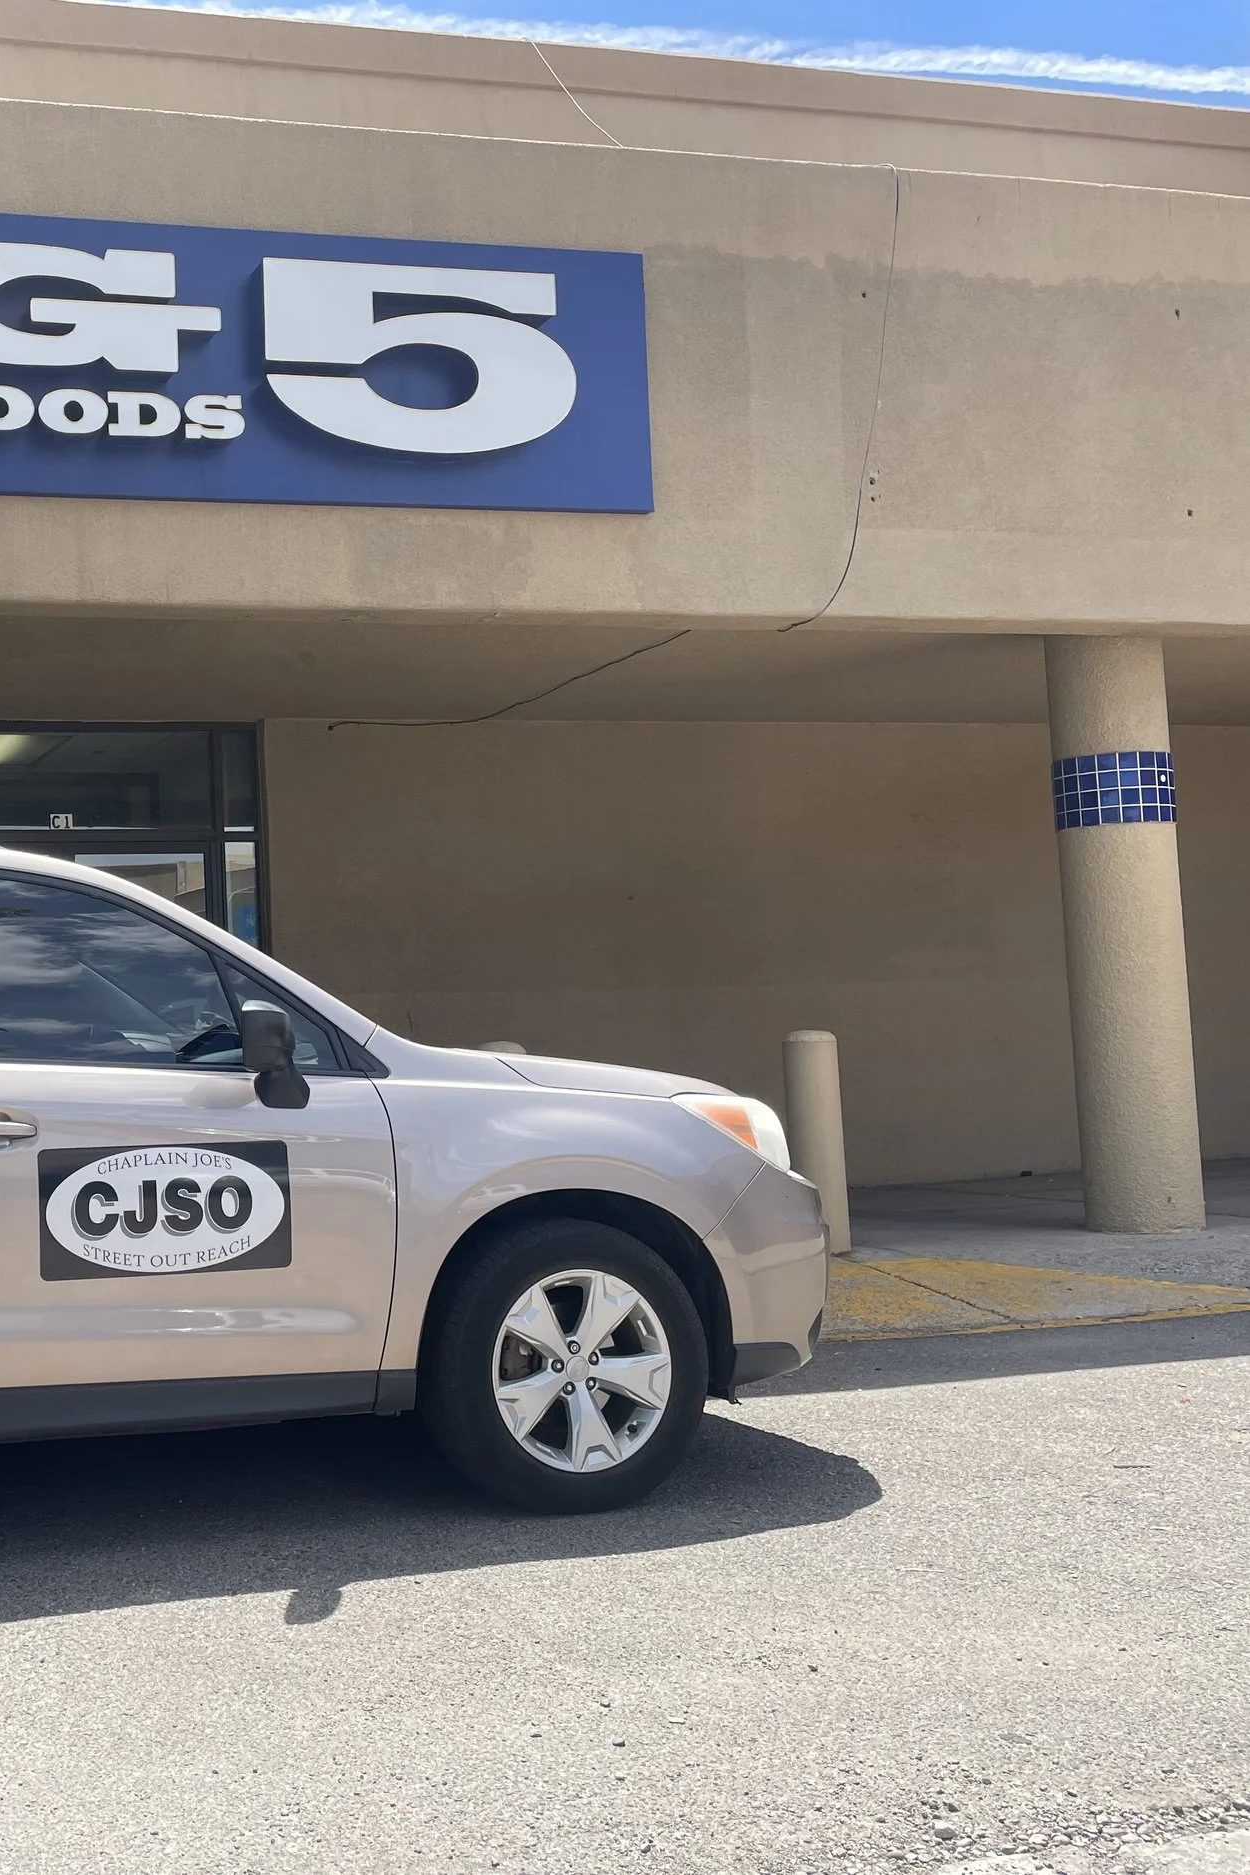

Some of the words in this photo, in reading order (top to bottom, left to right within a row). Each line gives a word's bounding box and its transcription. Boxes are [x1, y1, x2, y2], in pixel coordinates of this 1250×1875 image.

[261, 256, 578, 456] 5
[97, 1152, 188, 1175] CHAPLAIN
[192, 1152, 232, 1170] JOE'S
[71, 1175, 254, 1241] CJSO
[82, 1243, 145, 1267] STREET
[150, 1252, 191, 1267] OUT
[196, 1235, 251, 1263] REACH
